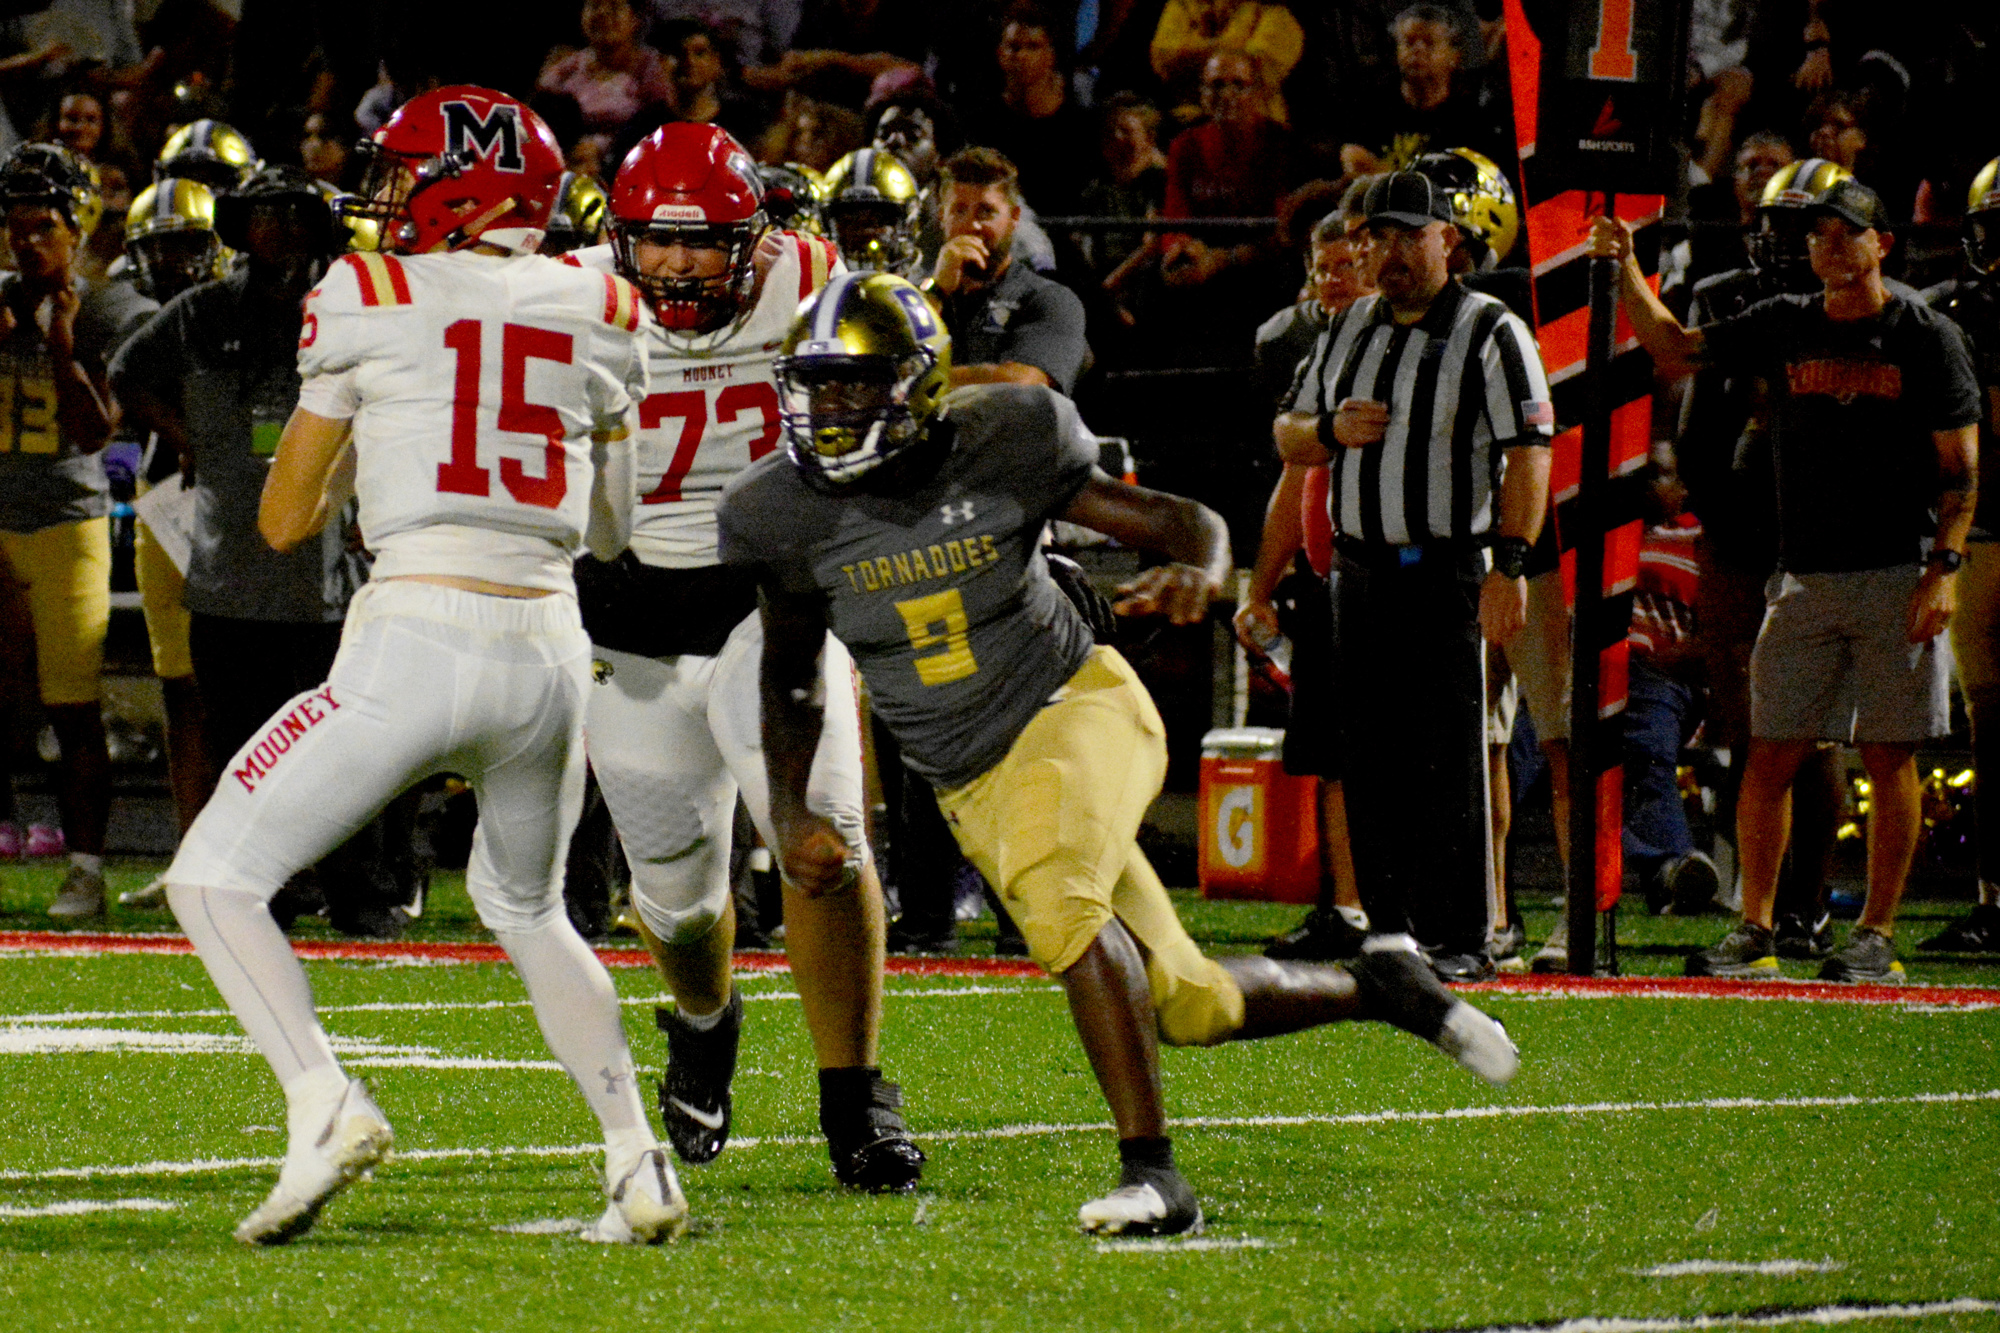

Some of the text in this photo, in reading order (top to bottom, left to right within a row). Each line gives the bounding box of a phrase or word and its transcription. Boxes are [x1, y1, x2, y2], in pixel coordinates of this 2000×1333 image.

[440, 101, 525, 174] M
[659, 209, 700, 219] riddell
[436, 318, 574, 510] 15
[683, 363, 735, 382] MOONEY
[638, 381, 783, 505] 73
[842, 534, 999, 593] TORNADOES
[894, 587, 979, 687] 9
[232, 686, 341, 795] MOONEY
[1216, 785, 1253, 868] G
